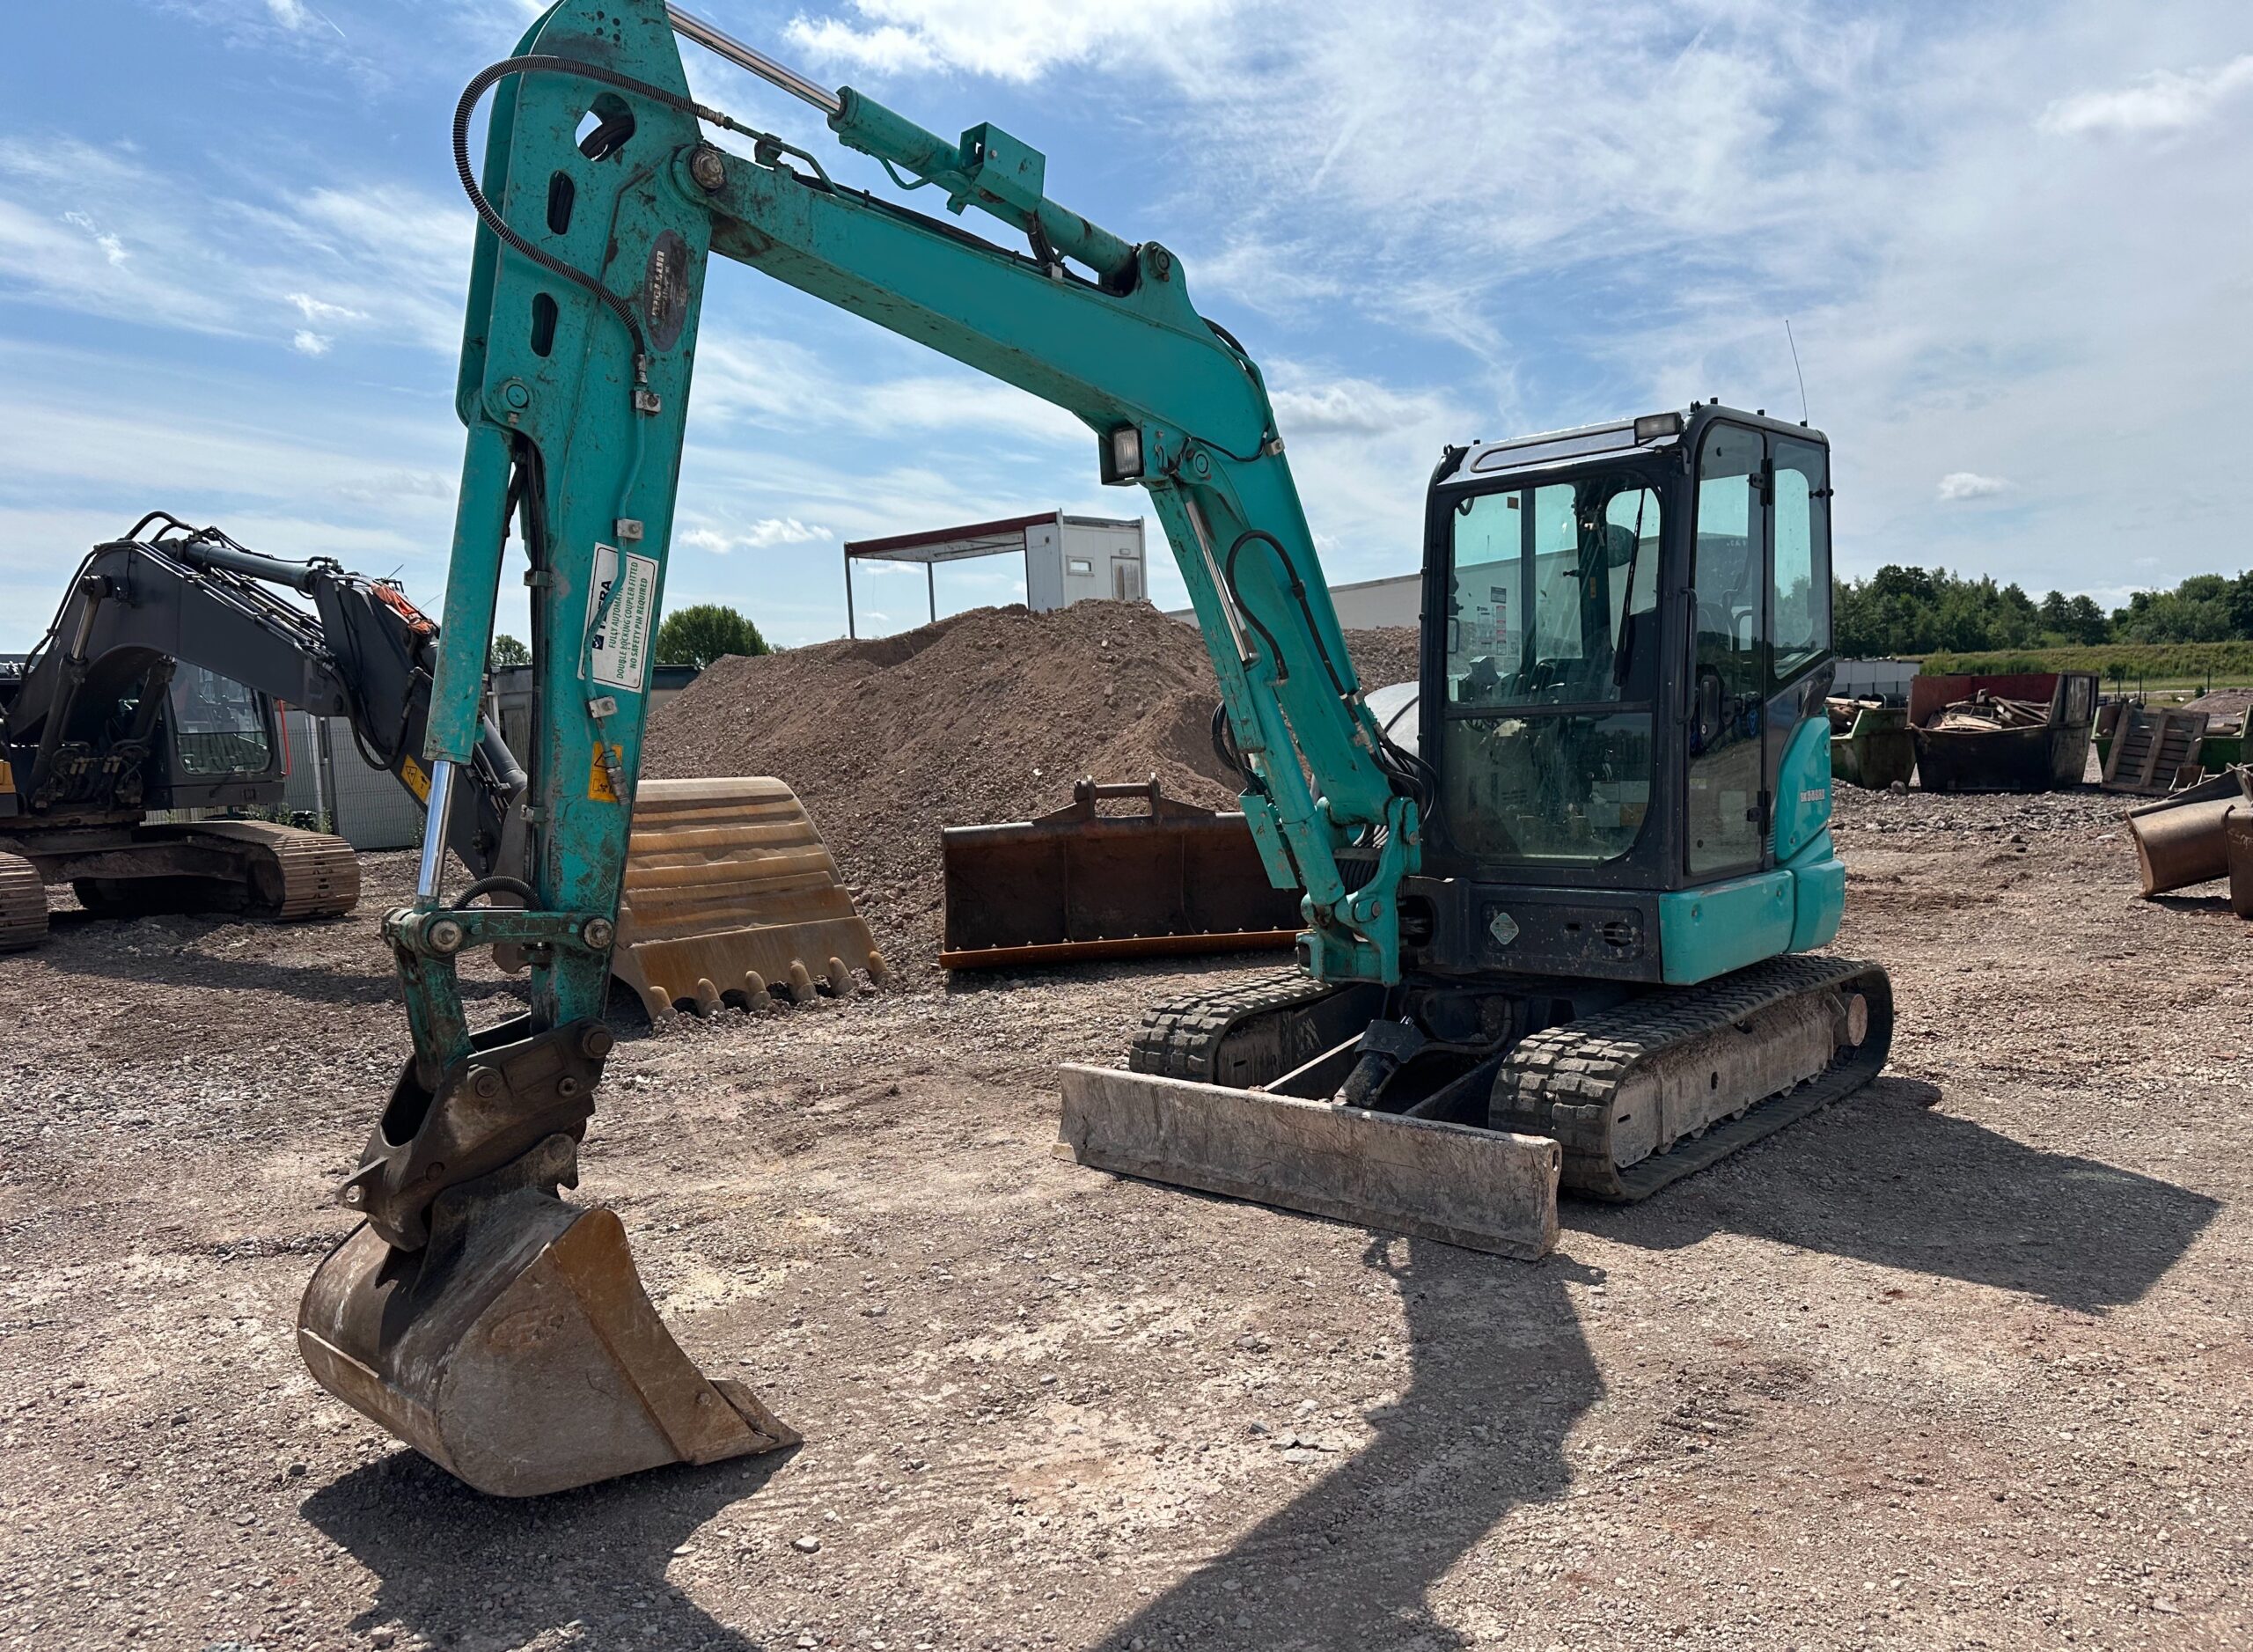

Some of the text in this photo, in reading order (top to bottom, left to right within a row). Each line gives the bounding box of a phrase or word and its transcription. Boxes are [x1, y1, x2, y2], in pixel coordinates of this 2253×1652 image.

[608, 627, 618, 649] FULLY
[616, 562, 638, 679] DOUBLE LOCKING COUPLER FITTED
[629, 577, 648, 669] NO SAFETY PIN REQUIRED
